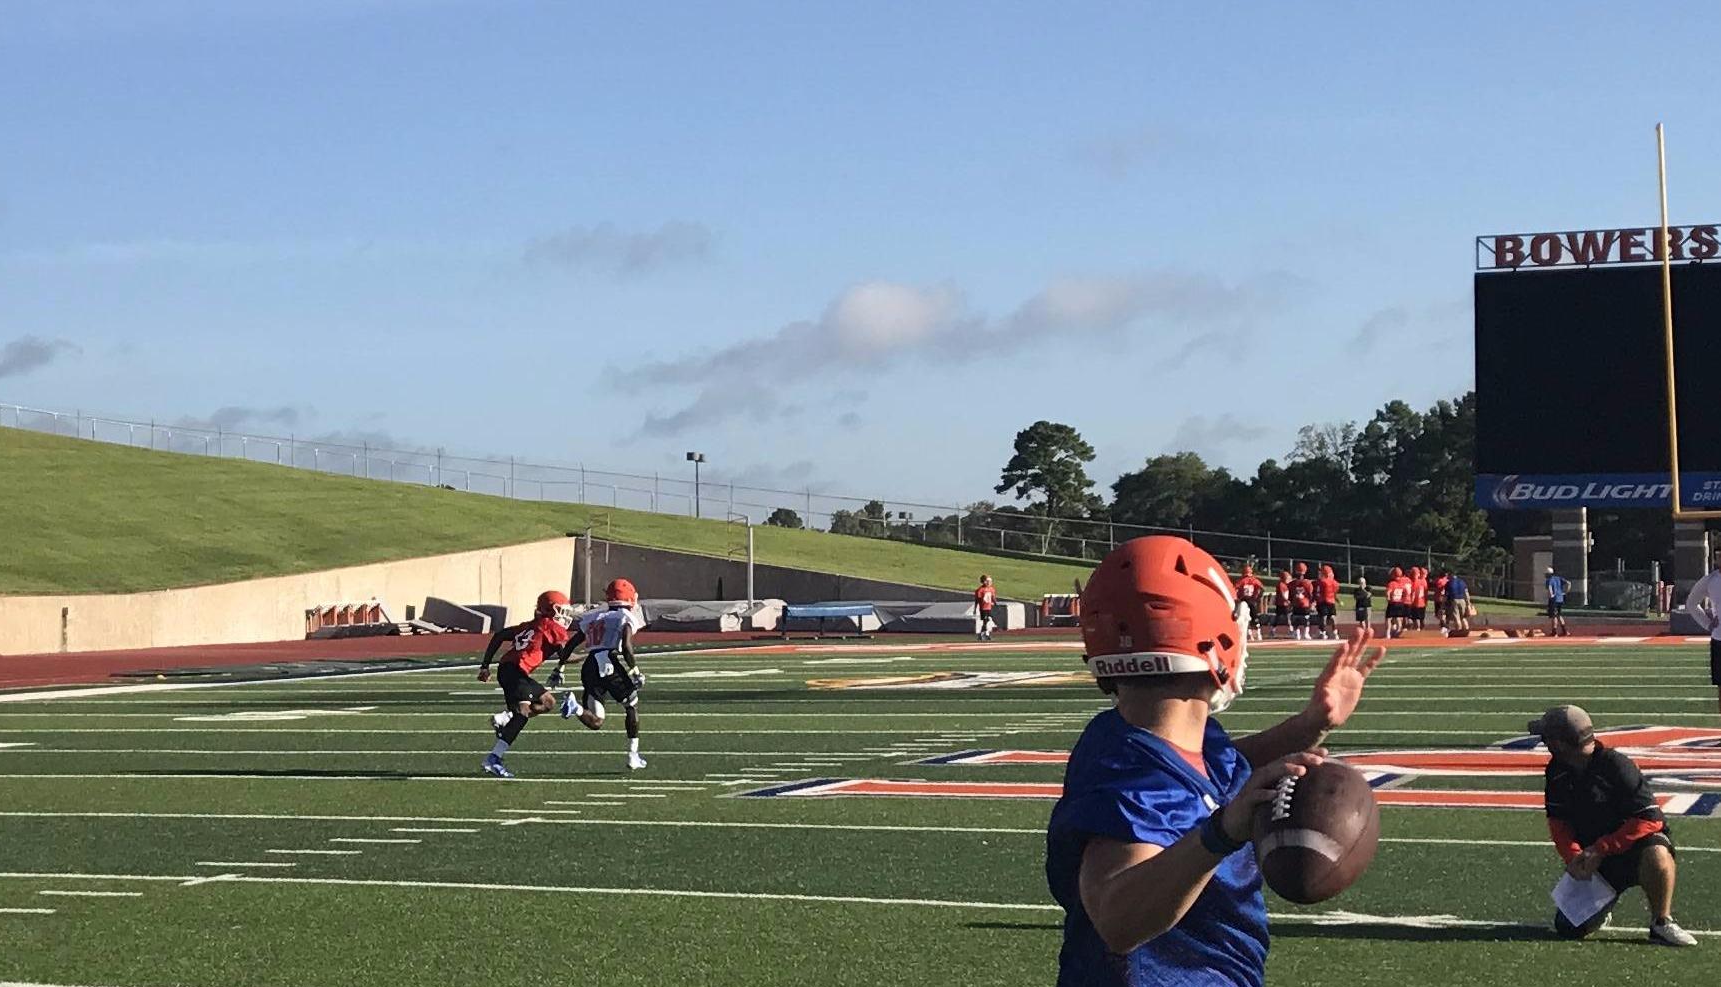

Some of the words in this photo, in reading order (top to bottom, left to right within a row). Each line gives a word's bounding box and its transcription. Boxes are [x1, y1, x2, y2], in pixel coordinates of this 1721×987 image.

[1495, 225, 1720, 267] BOWERS
[1508, 482, 1579, 500] BUD
[1581, 481, 1674, 499] LIGHT
[1095, 655, 1172, 675] Riddell
